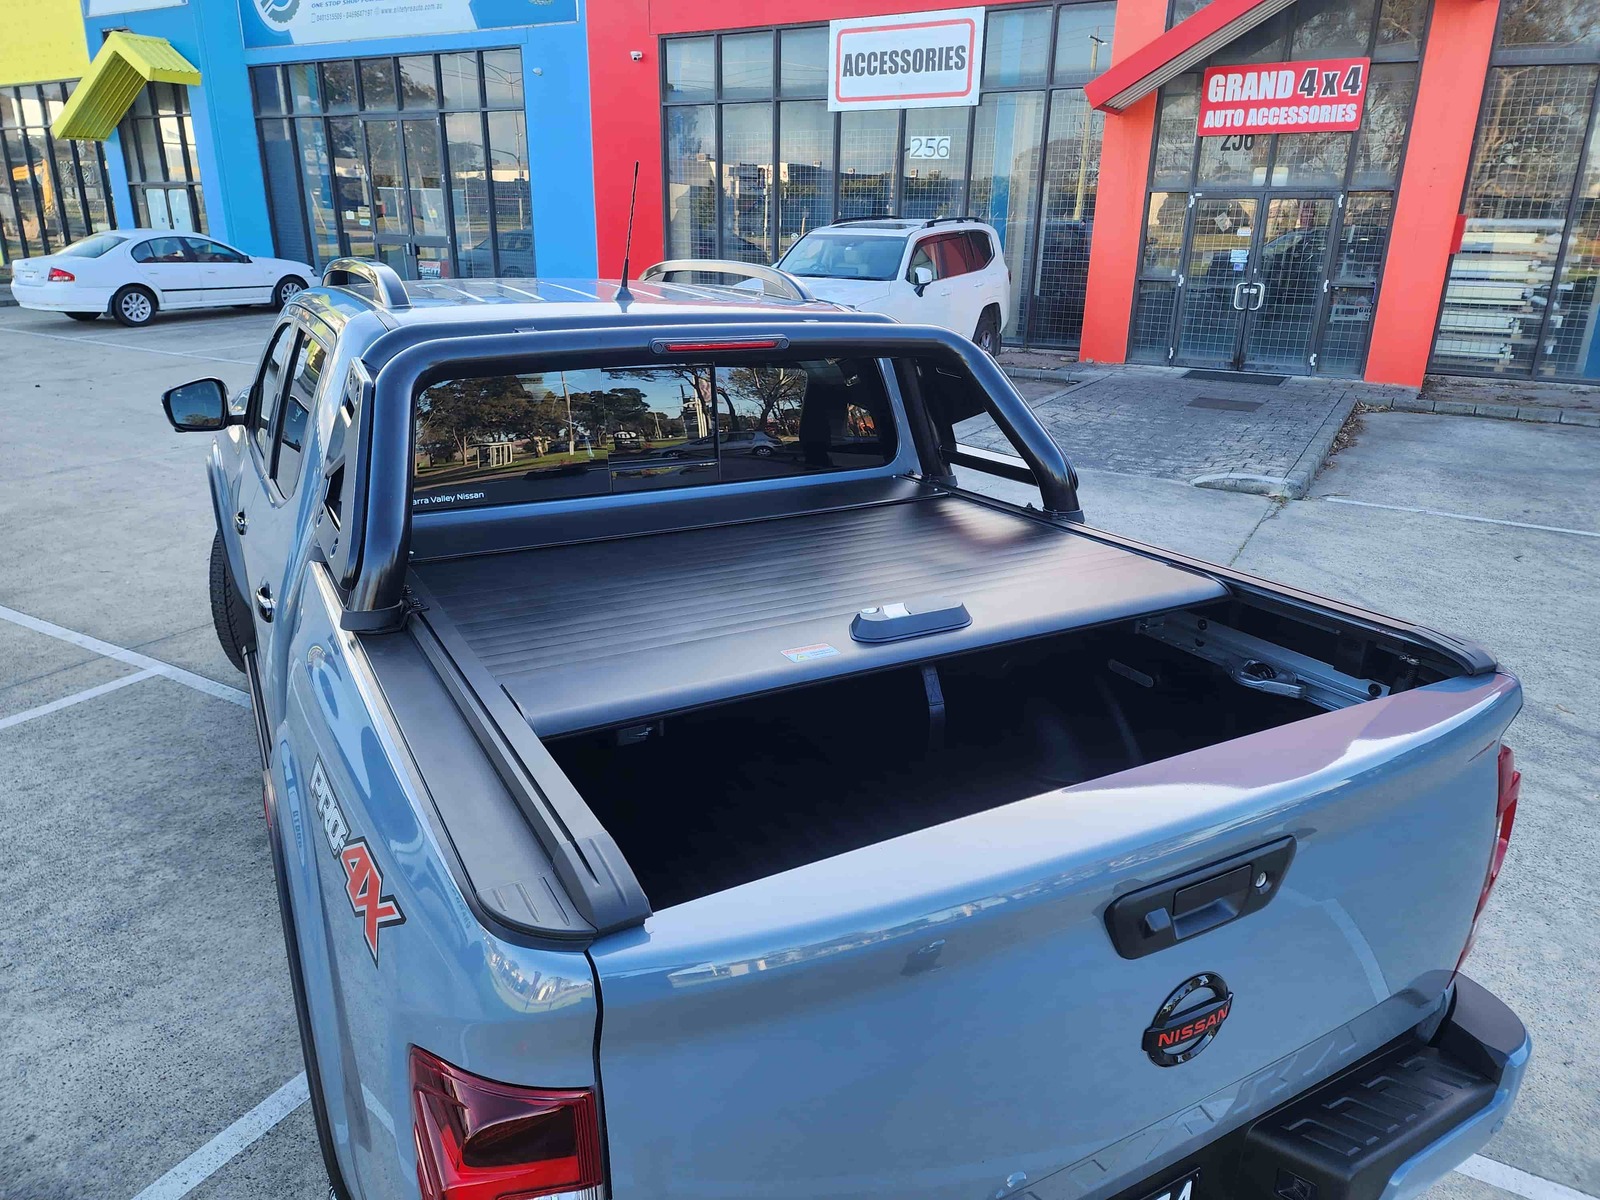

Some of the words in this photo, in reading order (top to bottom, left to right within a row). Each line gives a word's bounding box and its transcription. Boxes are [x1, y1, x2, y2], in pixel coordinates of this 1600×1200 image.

[842, 45, 966, 77] ACCESSORIES
[1207, 70, 1295, 103] GRAND
[1203, 109, 1245, 128] AUTO
[1246, 103, 1358, 127] ACCESSORIES
[910, 137, 949, 158] 256
[412, 498, 429, 506] arra
[430, 494, 455, 503] Valley
[456, 492, 485, 500] Nissan
[1157, 1005, 1229, 1047] NISSAN
